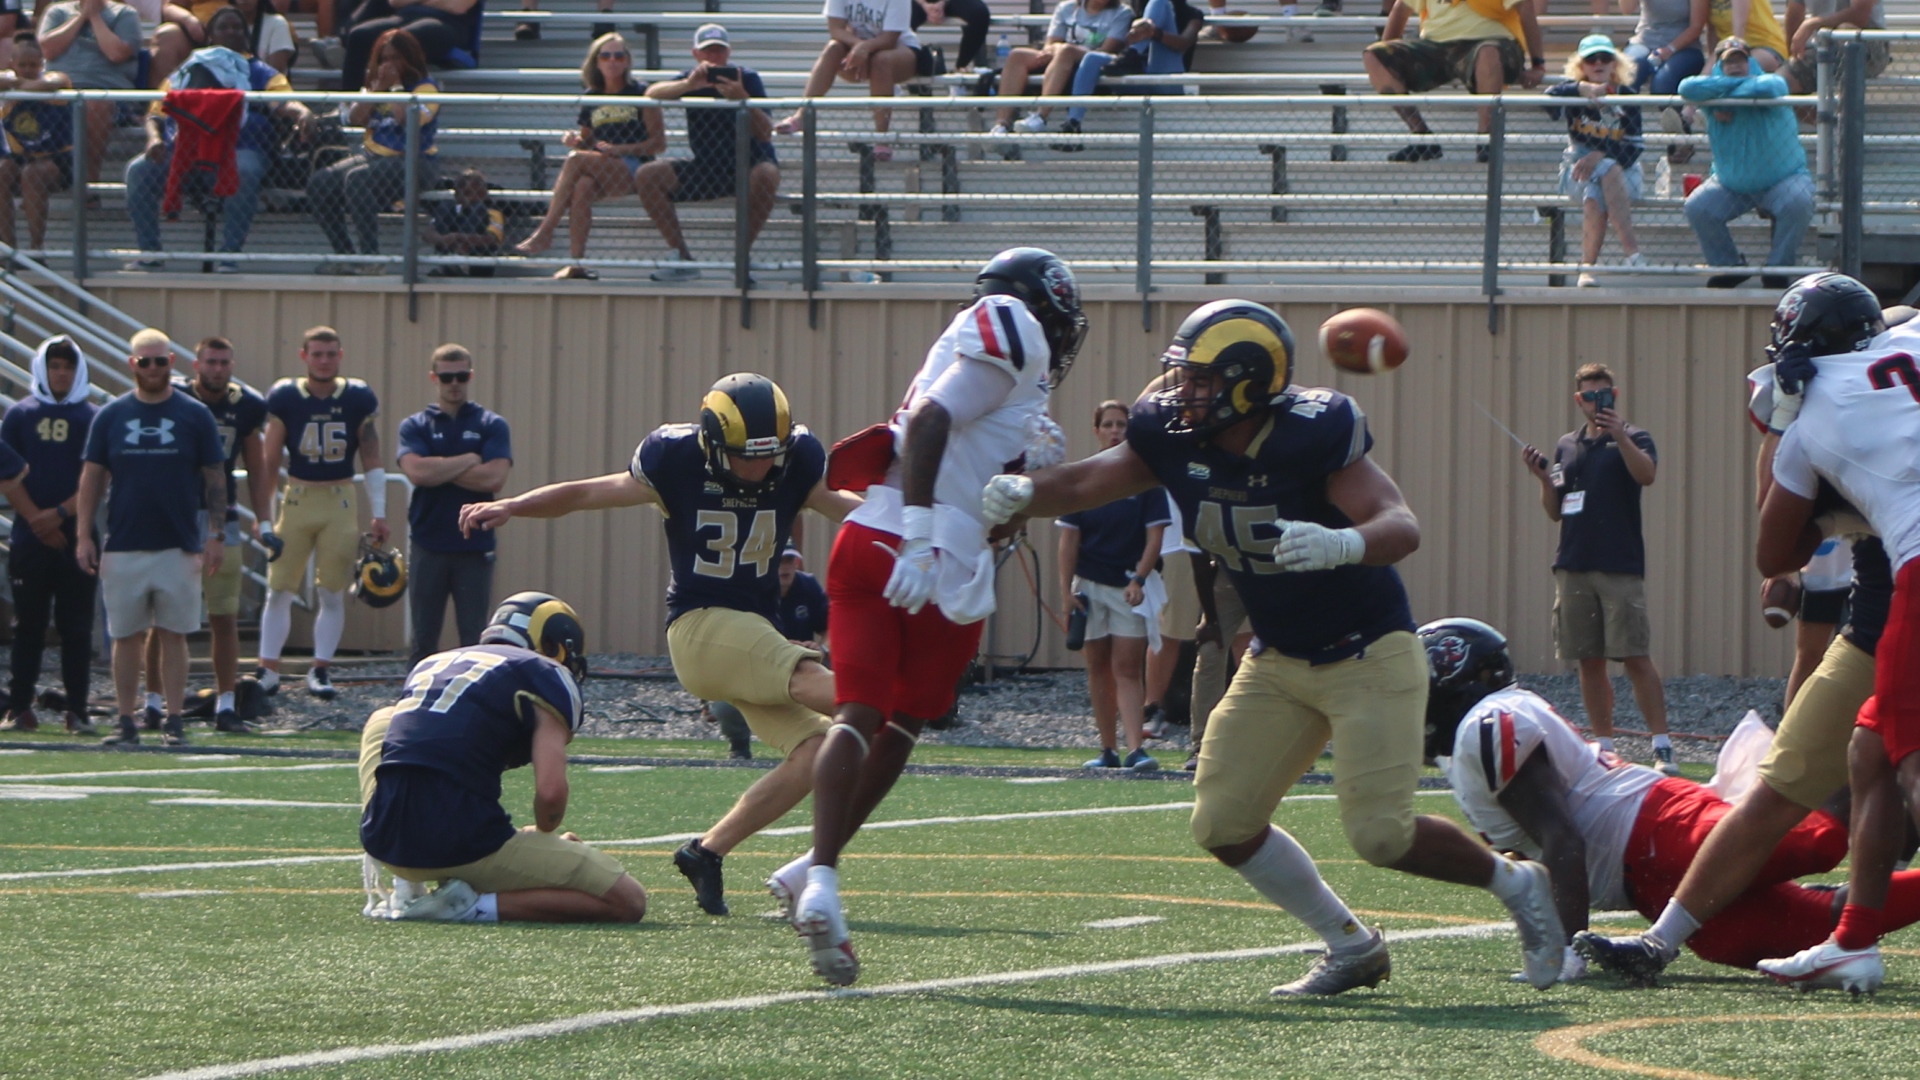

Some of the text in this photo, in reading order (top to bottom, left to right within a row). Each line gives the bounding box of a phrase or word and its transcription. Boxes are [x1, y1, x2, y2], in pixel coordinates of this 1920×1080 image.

[37, 417, 69, 442] 48
[1290, 389, 1333, 419] 45
[299, 422, 347, 463] 46
[693, 509, 777, 579] 34
[1194, 501, 1287, 574] 45
[392, 651, 508, 715] 37
